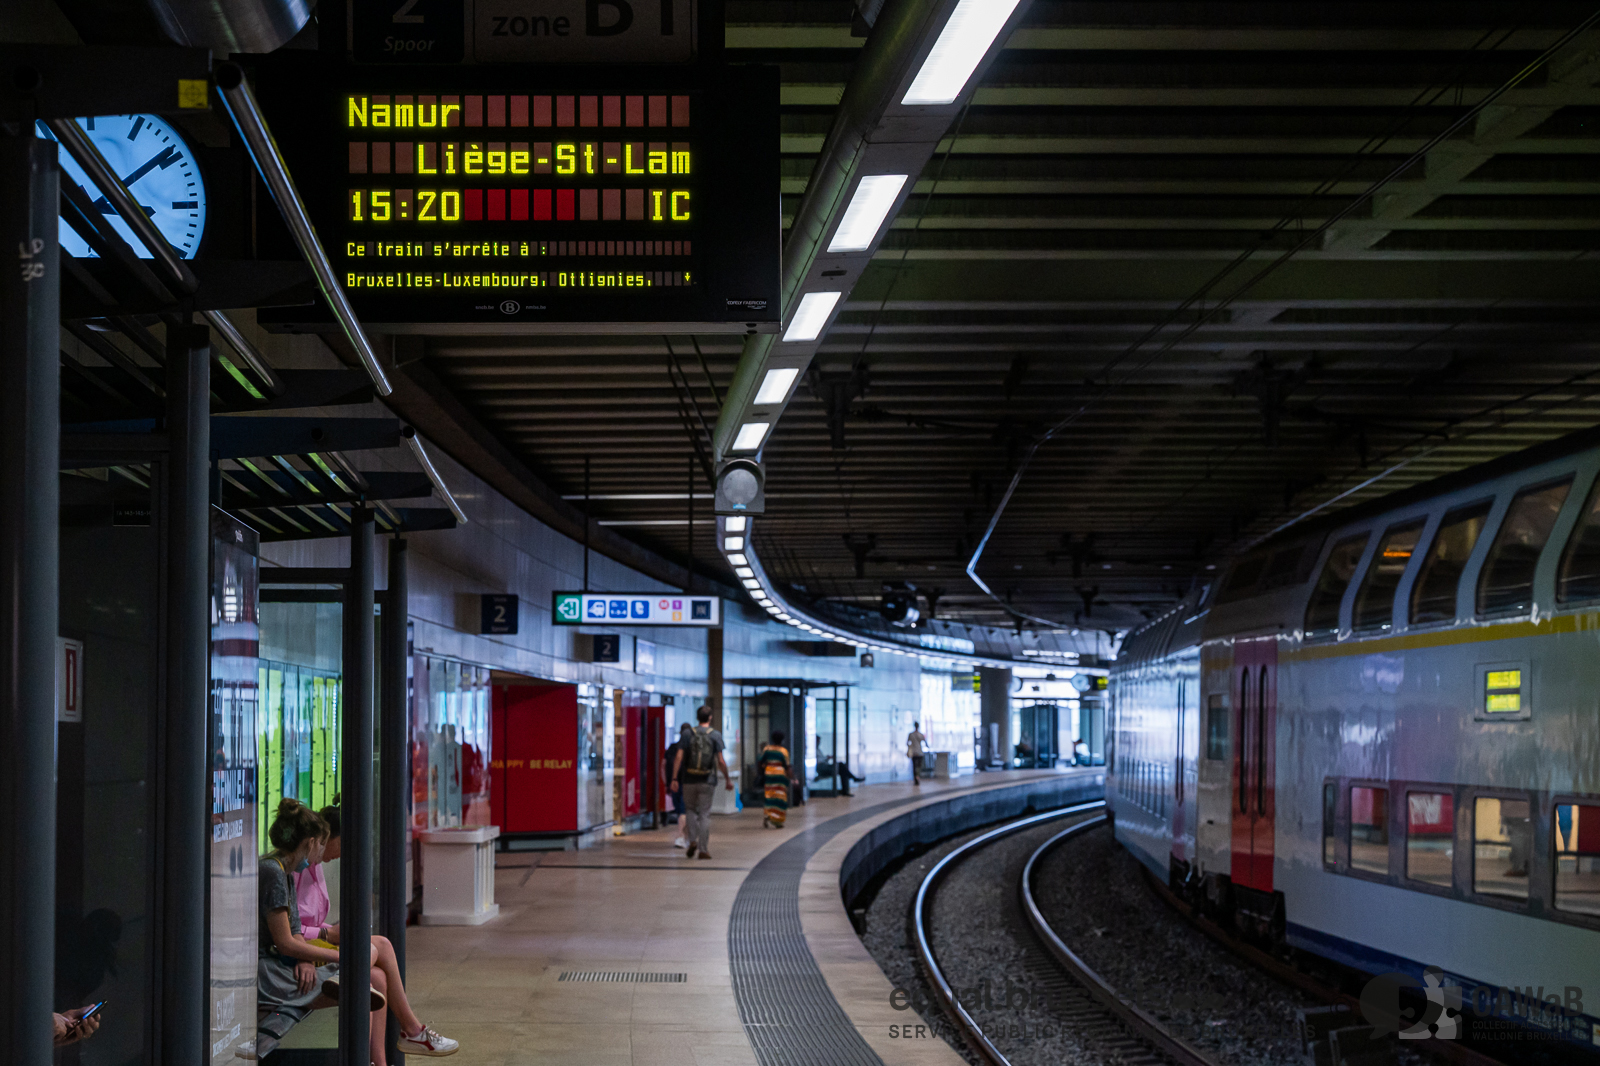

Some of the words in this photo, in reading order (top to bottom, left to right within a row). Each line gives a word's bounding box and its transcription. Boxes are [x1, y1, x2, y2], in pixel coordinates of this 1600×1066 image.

[492, 15, 571, 37] zone
[383, 35, 436, 54] Spoor
[348, 97, 460, 128] Namur
[418, 143, 691, 175] Liège-St-Lam
[352, 191, 460, 221] 15:20
[652, 191, 690, 221] IC
[347, 242, 365, 257] Ce
[377, 242, 423, 257] train
[433, 242, 510, 257] s'arrête
[520, 241, 529, 256] à
[347, 272, 546, 287] Bruxelles-Luxembourg,
[558, 272, 651, 287] Ottignies,
[494, 605, 506, 623] 2
[602, 641, 611, 655] 2
[543, 759, 573, 769] RELAY
